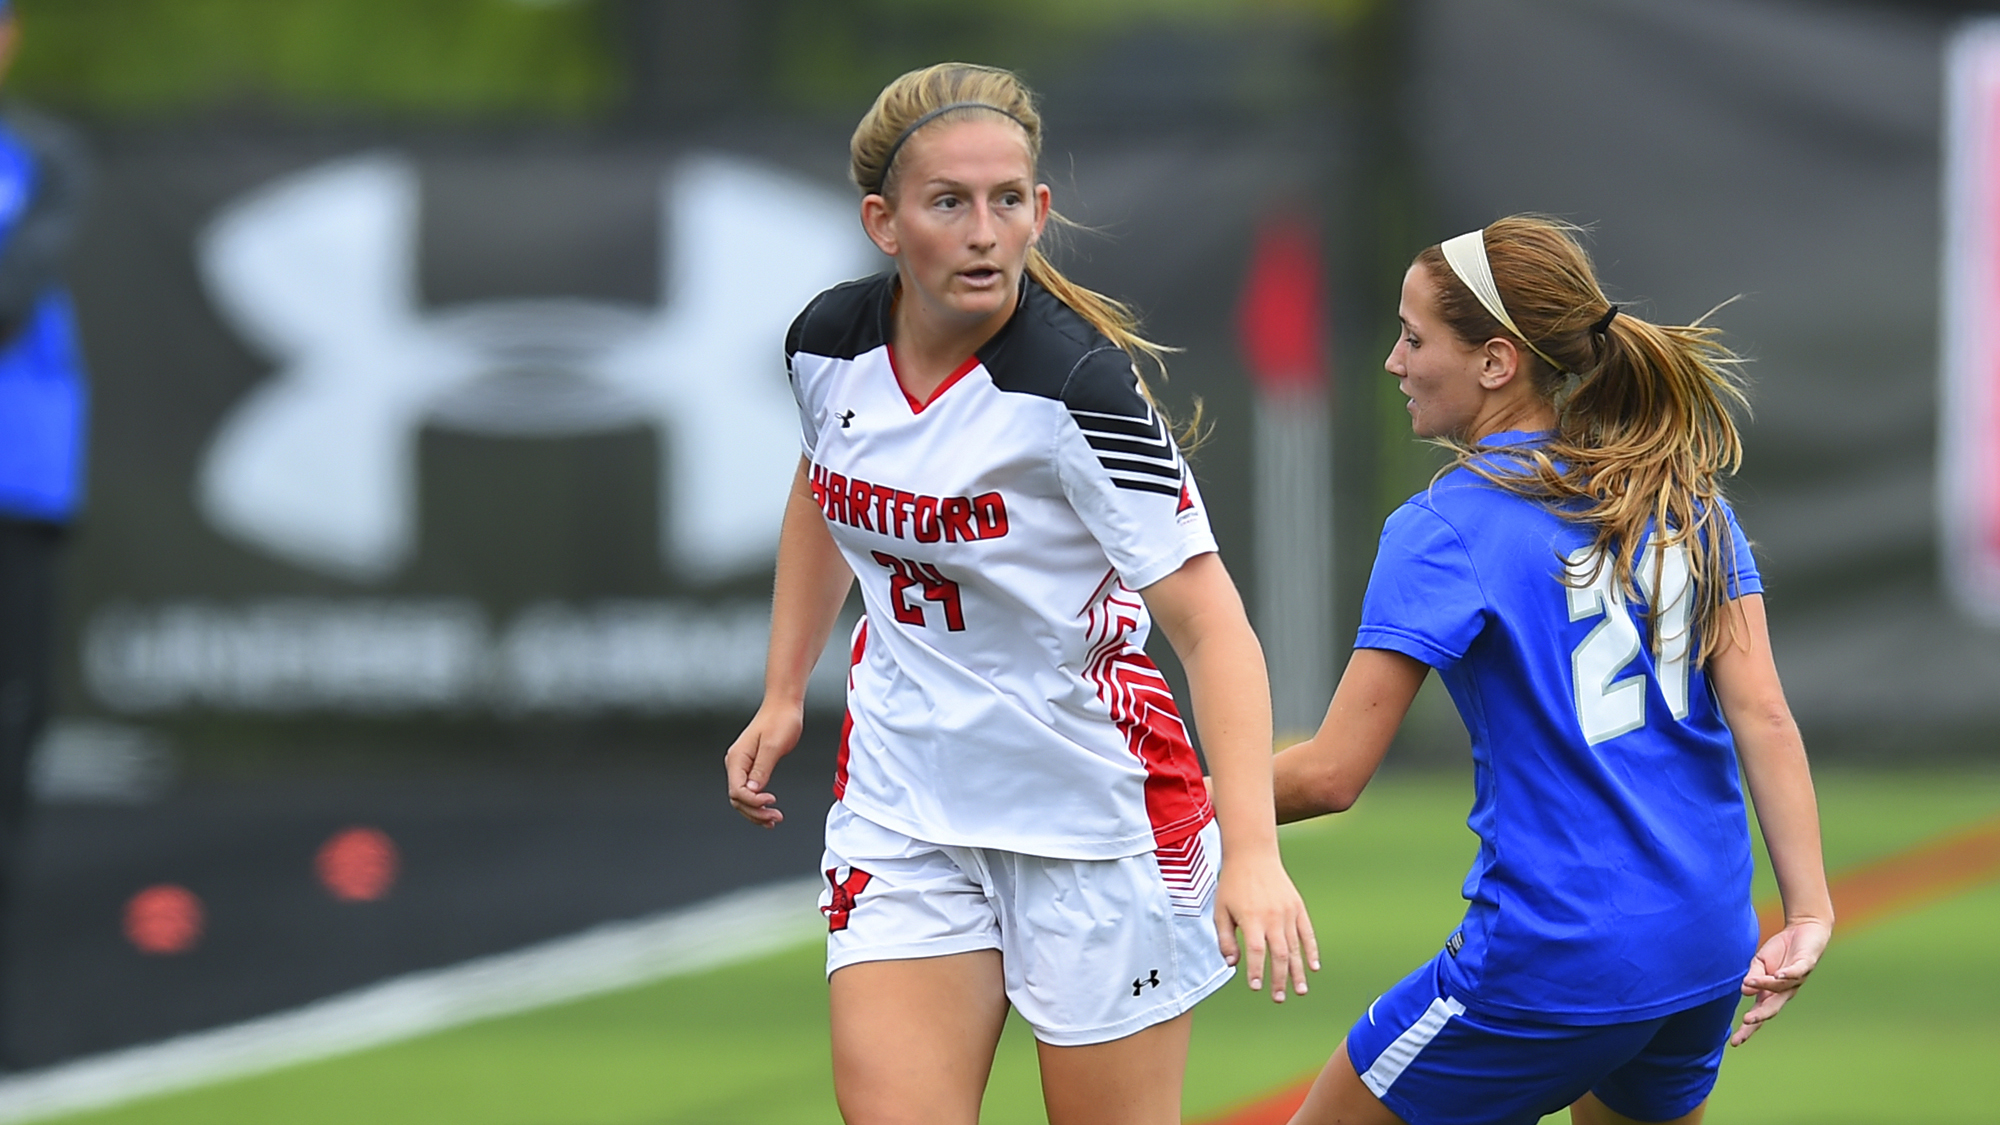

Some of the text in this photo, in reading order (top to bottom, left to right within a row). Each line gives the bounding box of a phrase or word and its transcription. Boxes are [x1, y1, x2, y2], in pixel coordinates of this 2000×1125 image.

[811, 463, 1009, 543] HARTFORD
[871, 550, 966, 632] 24
[1565, 528, 1695, 746] 21
